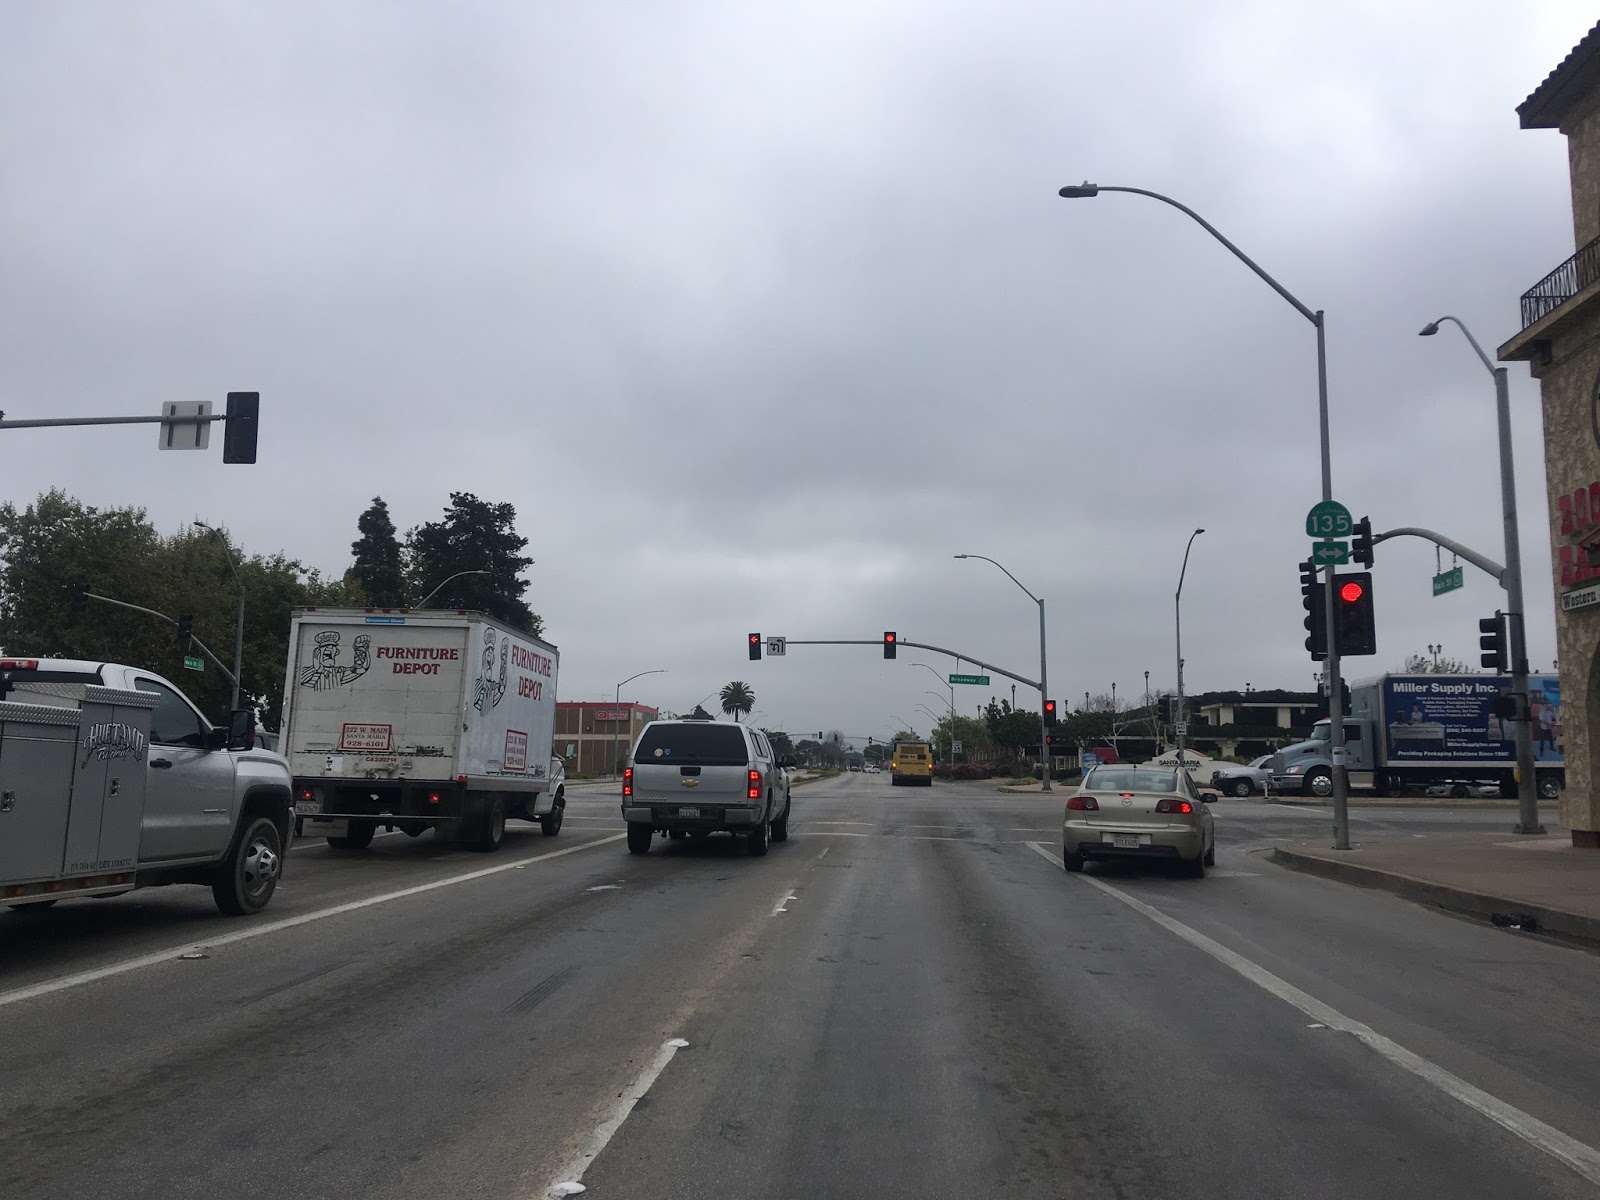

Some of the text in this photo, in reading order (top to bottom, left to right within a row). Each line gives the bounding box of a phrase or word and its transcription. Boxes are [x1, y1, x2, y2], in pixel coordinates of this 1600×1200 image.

[1311, 515, 1349, 533] 135
[1562, 591, 1597, 608] Western
[376, 646, 459, 660] FURNITURE
[511, 644, 552, 677] FURNITURE
[392, 662, 441, 675] DEPOT
[518, 675, 543, 701] DEPOT
[1393, 682, 1499, 694] Miller Supply Inc.
